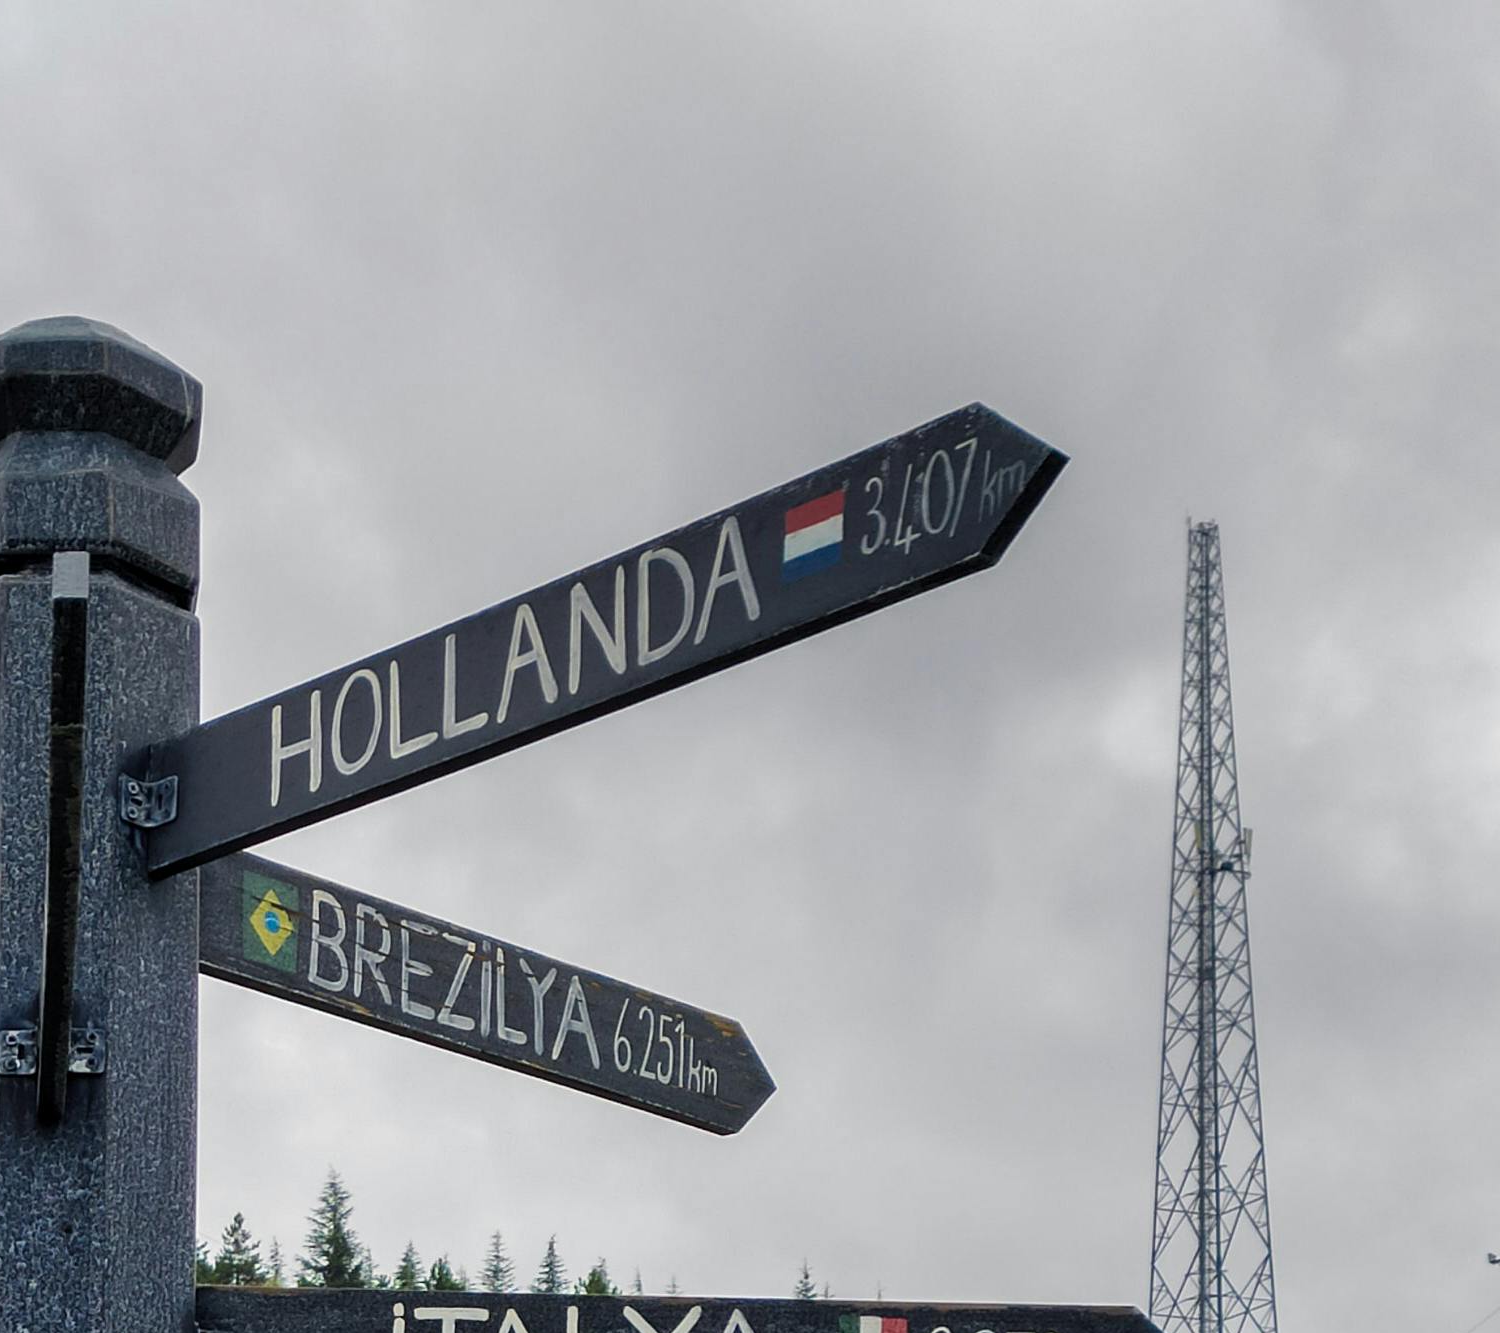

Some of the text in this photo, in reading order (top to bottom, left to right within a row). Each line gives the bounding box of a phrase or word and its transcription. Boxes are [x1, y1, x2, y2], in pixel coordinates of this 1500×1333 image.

[269, 437, 1027, 807] HOLLANDA 3.407 km
[308, 889, 718, 1096] BREZİLYA 6.251 km
